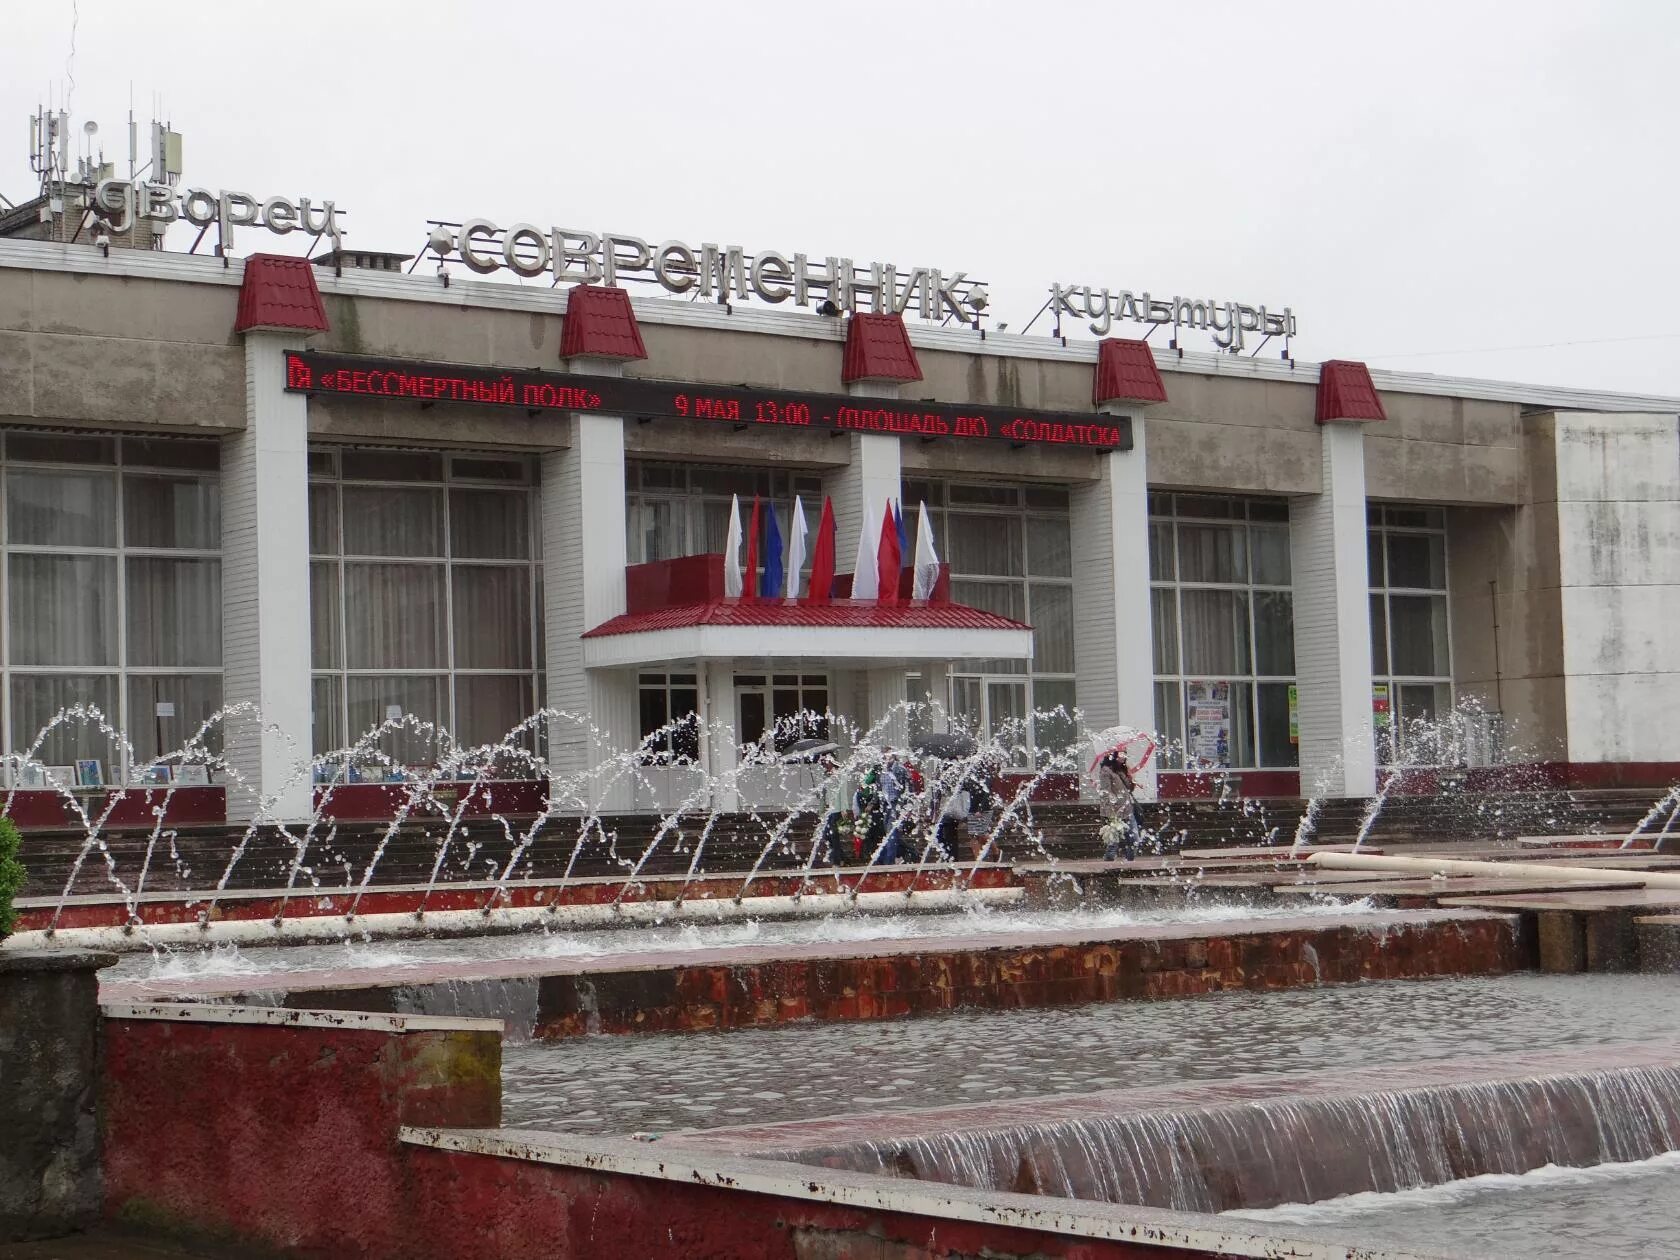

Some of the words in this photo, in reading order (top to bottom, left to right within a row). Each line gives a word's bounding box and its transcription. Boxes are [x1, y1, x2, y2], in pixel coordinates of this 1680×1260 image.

[321, 370, 516, 404] «БЕССМЕРТНЫЙ
[524, 383, 601, 409] ПОЛК»
[674, 394, 689, 417] 9
[695, 398, 740, 421] МАЯ
[756, 400, 810, 425] 13:00
[837, 406, 949, 435] (ПЛОЩАДЬ
[953, 415, 989, 437] ДК)
